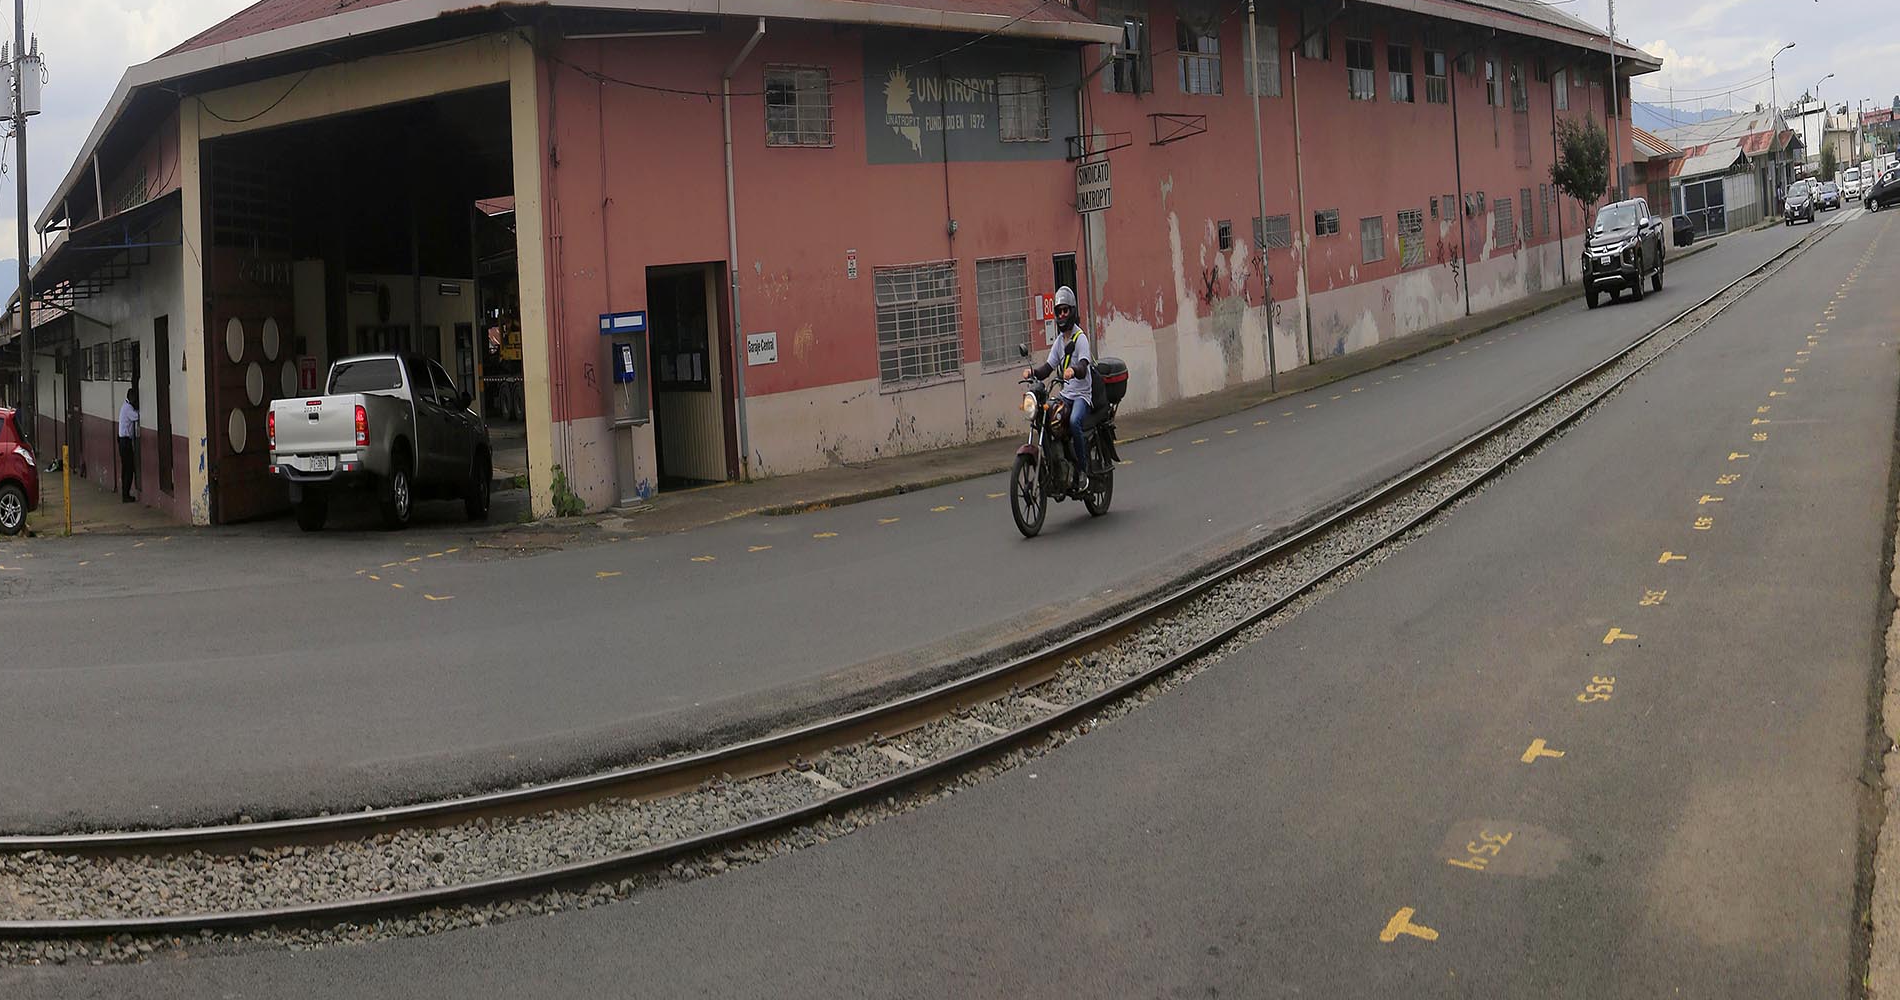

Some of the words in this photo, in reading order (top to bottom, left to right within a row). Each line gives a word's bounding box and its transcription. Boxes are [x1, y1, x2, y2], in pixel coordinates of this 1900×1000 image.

[916, 77, 994, 103] UNATROPYT
[885, 113, 920, 127] UNATROPYT
[970, 113, 985, 129] 1972
[1078, 163, 1109, 186] SINDICATO
[1077, 187, 1111, 211] UNATROPYT
[1447, 829, 1512, 873] 354
